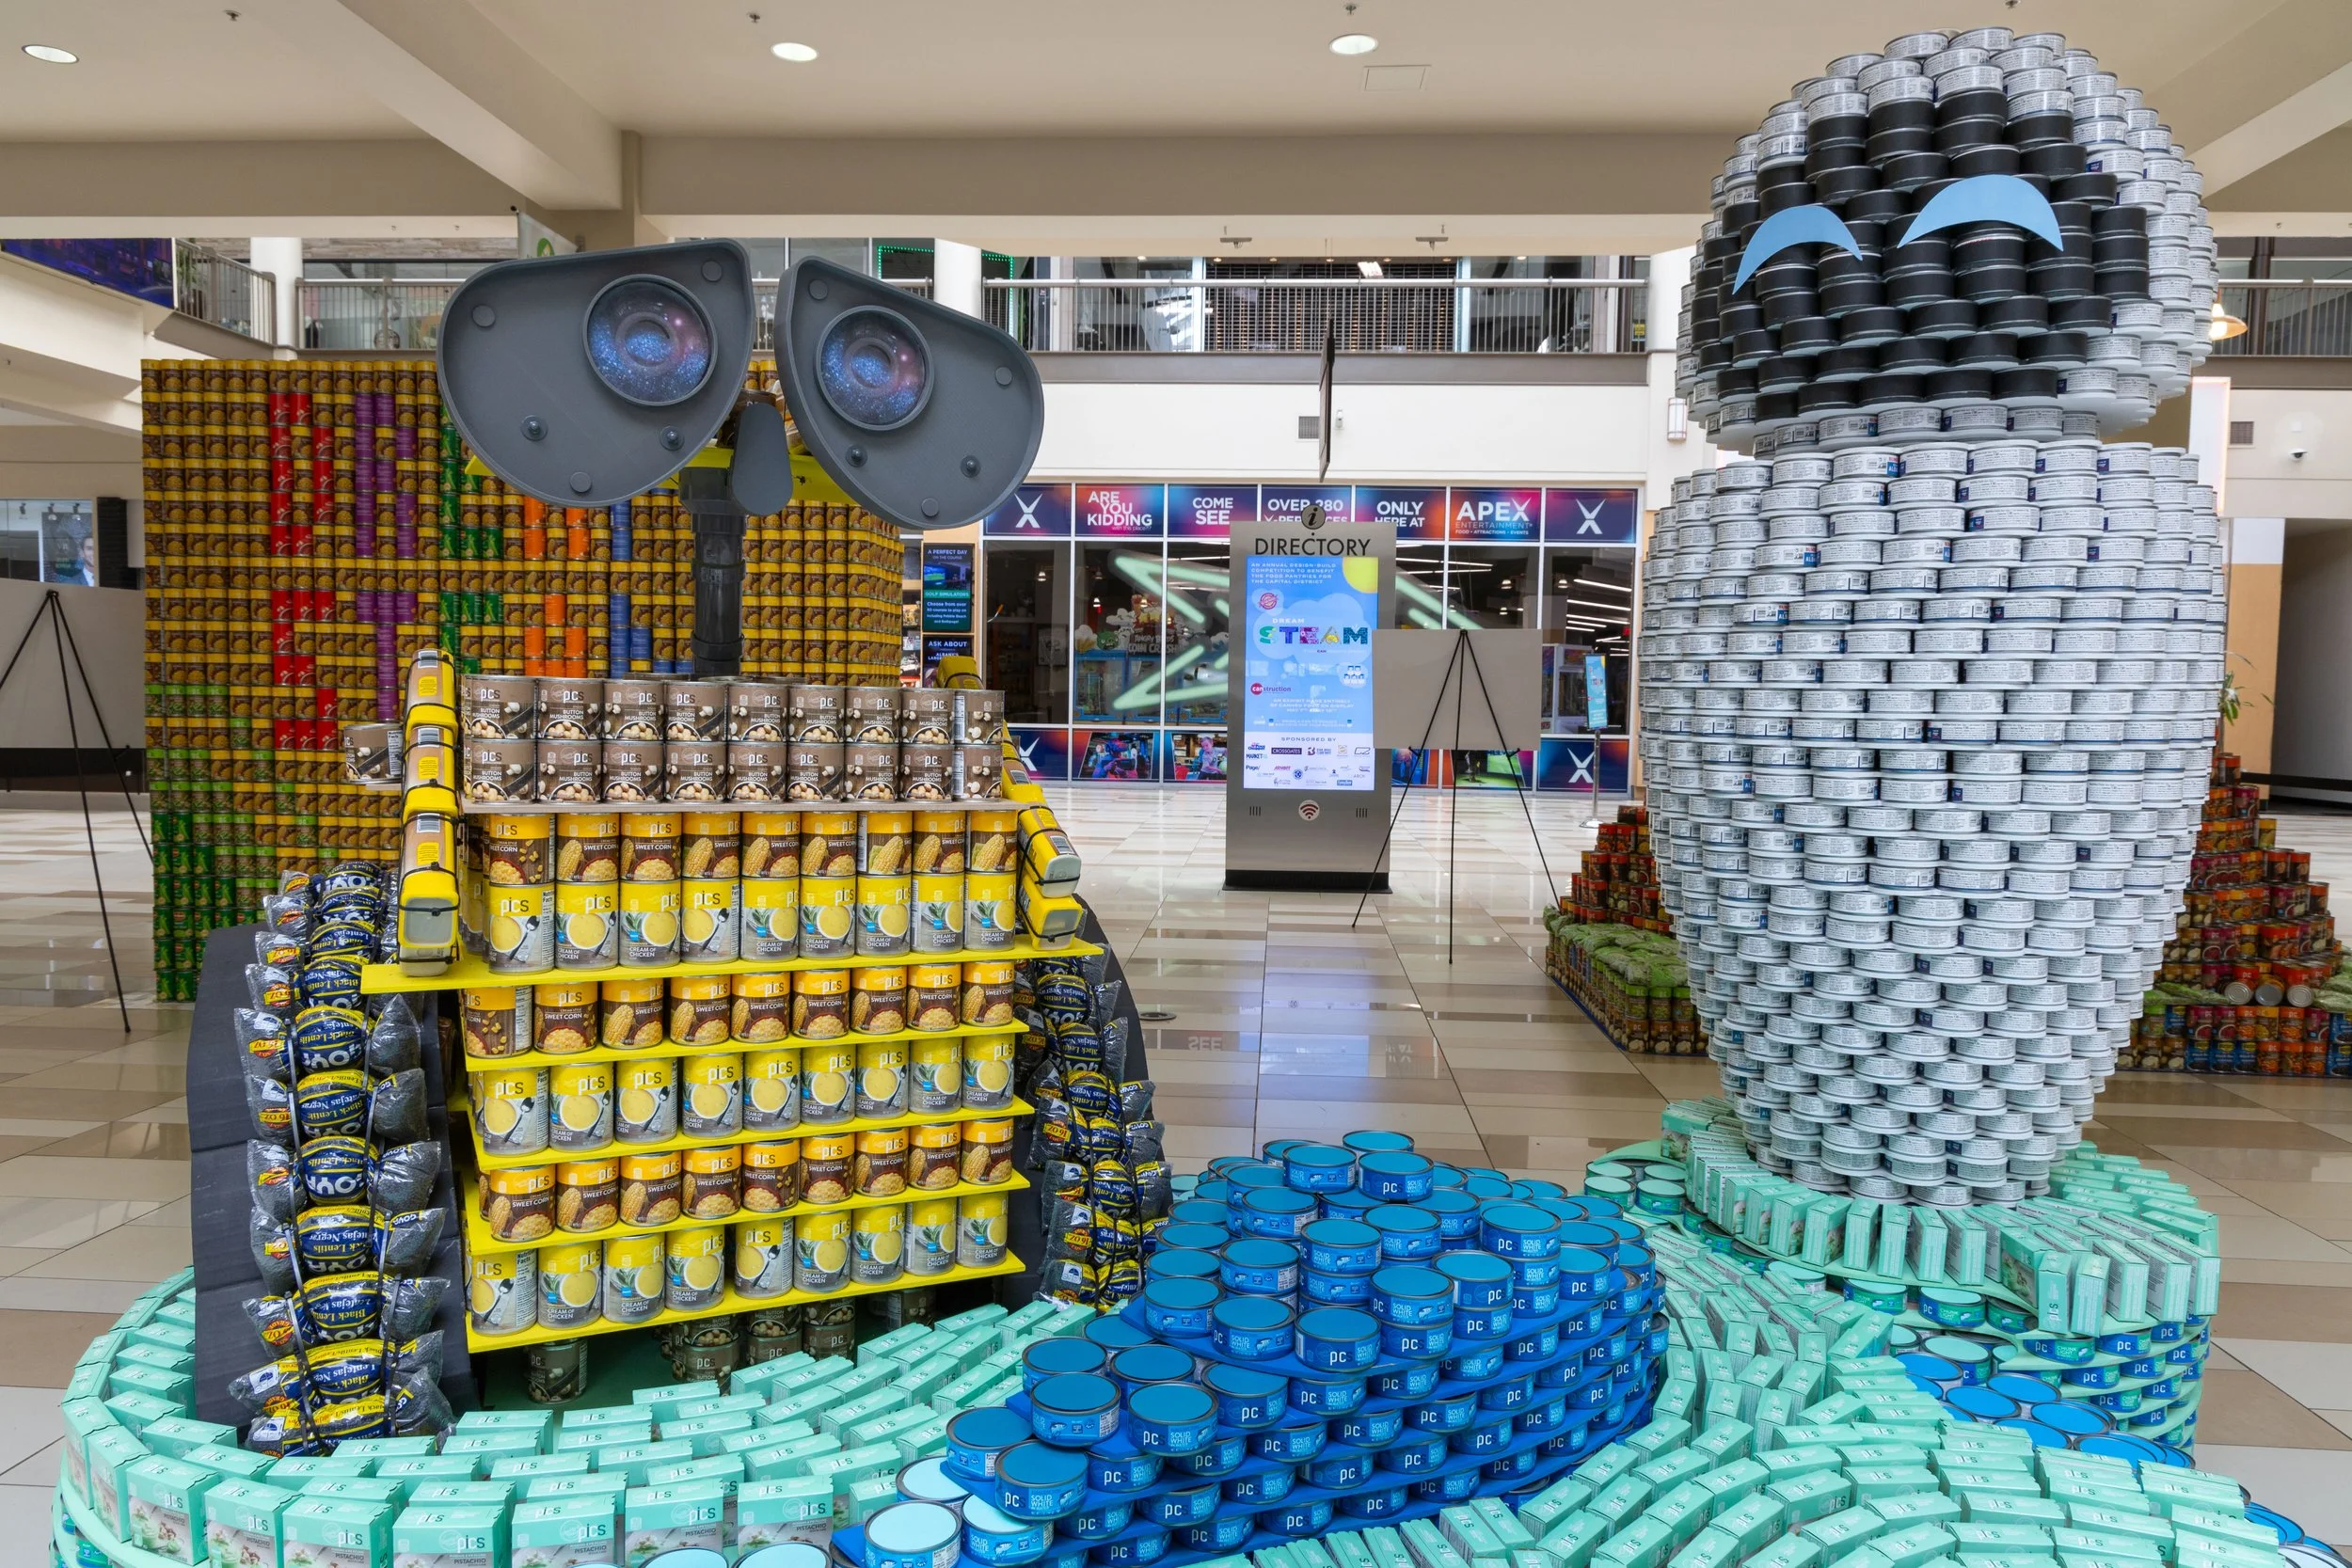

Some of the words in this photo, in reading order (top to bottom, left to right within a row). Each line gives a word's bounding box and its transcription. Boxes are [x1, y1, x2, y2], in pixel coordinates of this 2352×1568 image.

[1088, 491, 1120, 503] ARE
[1193, 497, 1233, 509] COME
[1101, 503, 1133, 515] YOU
[1267, 499, 1310, 512] OVER
[1376, 501, 1423, 515] ONLY
[1455, 497, 1532, 521] APEX
[1087, 514, 1152, 527] KIDDING
[1195, 510, 1230, 525] SEE
[1375, 516, 1407, 528] HERE
[1408, 517, 1425, 528] AT
[1256, 538, 1371, 556] DIRECTORY
[1260, 626, 1368, 644] STEAM
[1129, 643, 1148, 654] COIN
[1150, 644, 1176, 654] CRSH
[496, 821, 517, 836] pics
[649, 820, 672, 837] pics
[585, 894, 612, 914] pics
[693, 891, 721, 910] pics
[834, 887, 854, 906] pics
[500, 896, 530, 917] pics
[933, 971, 953, 987] pics
[765, 979, 785, 997] pics
[558, 990, 582, 1007] pics
[768, 1060, 793, 1079] pics
[578, 1075, 605, 1096] pics
[634, 1070, 662, 1089] pics
[495, 1080, 524, 1100] pics
[278, 1113, 290, 1121] 16
[1047, 1126, 1060, 1134] OZ
[1060, 1128, 1068, 1136] 16
[754, 1152, 776, 1167] pics
[821, 1144, 843, 1161] pics
[711, 1156, 733, 1174] pics
[528, 1175, 549, 1194] pics
[532, 1196, 549, 1205] CORN
[392, 1214, 417, 1227] GOYA
[745, 1228, 771, 1246] pics
[313, 1244, 346, 1254] Lentils
[476, 1259, 502, 1278] pics
[517, 1256, 531, 1265] Facts
[621, 1305, 648, 1313] CHICKEN
[512, 1461, 538, 1472] pics
[247, 1513, 269, 1532] pics
[689, 1505, 716, 1526] pics
[338, 1528, 363, 1547] pics
[578, 1522, 607, 1543] pics
[685, 1528, 717, 1537] PISTACHIO
[246, 1537, 270, 1546] PISTACHIO
[457, 1535, 485, 1554] pics
[574, 1544, 607, 1555] PISTACHIO
